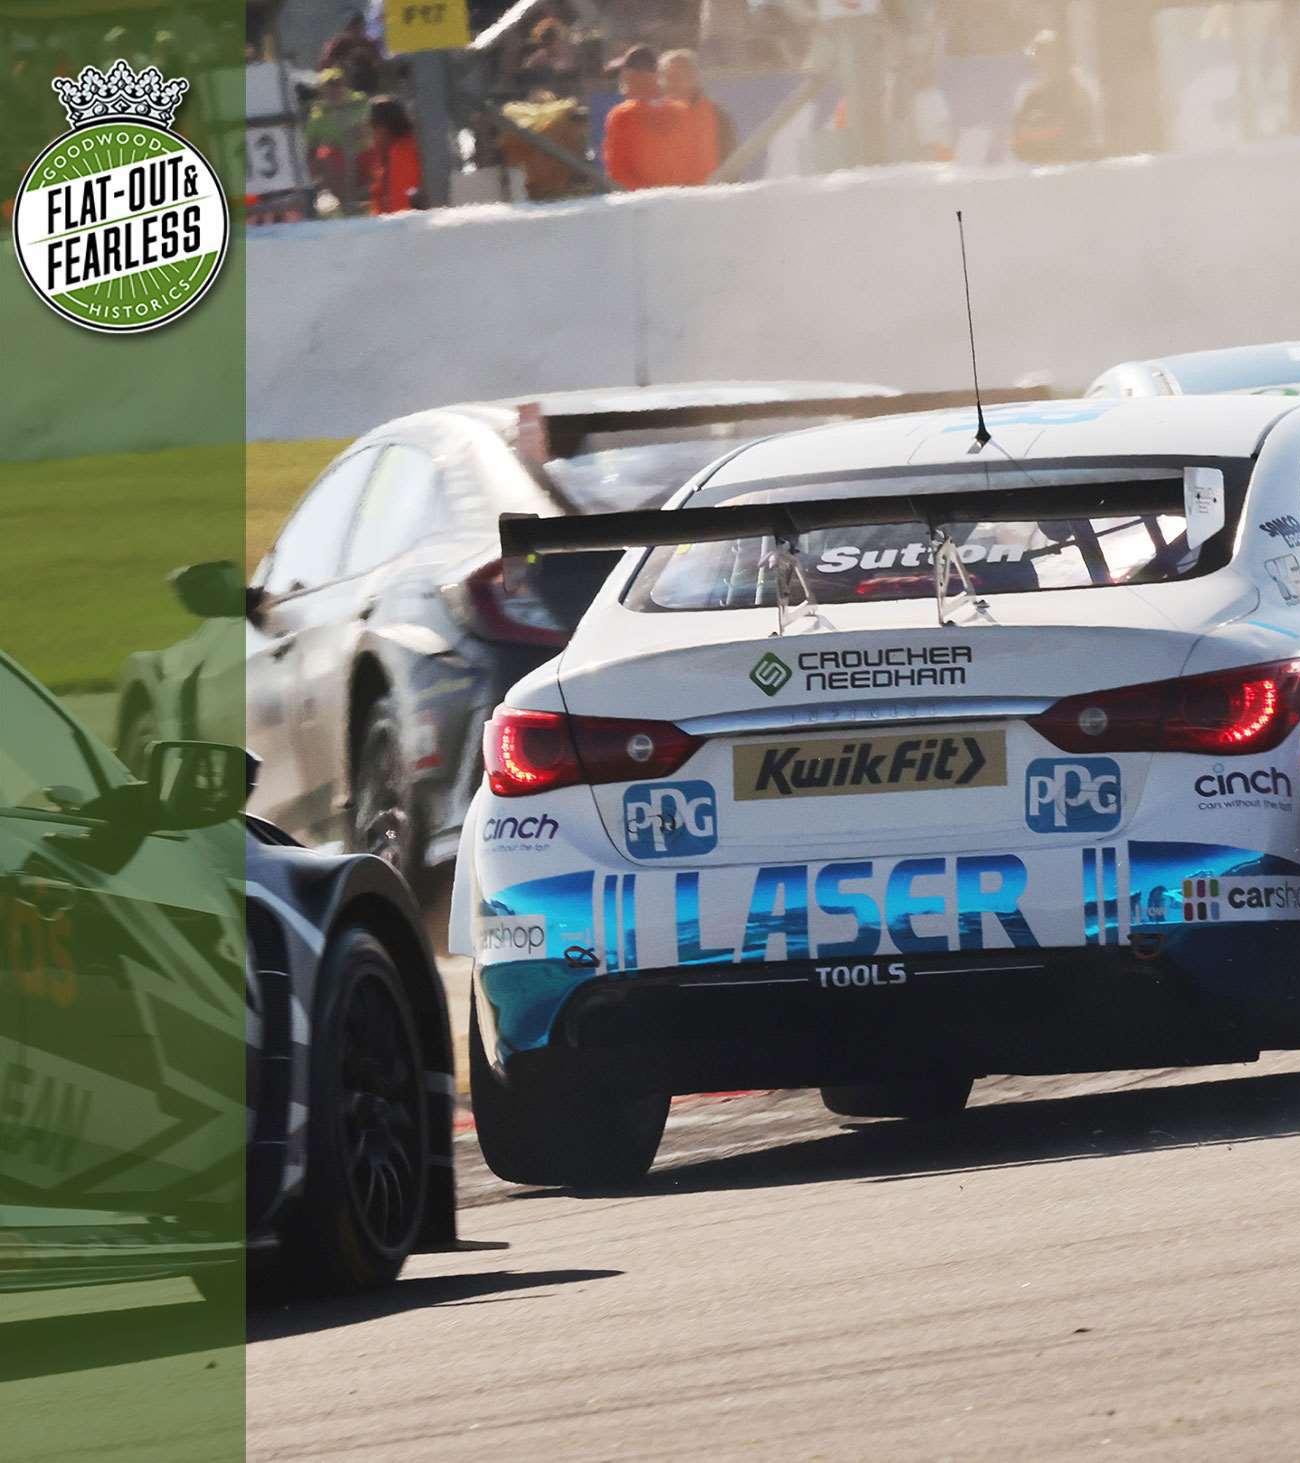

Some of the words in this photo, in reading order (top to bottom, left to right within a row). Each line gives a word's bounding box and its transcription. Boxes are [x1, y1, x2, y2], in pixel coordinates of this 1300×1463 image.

[798, 645, 972, 671] CROUCHER
[806, 666, 966, 691] NEEDHAM
[1028, 764, 1118, 827] PPG
[1194, 762, 1293, 798] cinch
[483, 813, 561, 842] cinch
[626, 788, 714, 852] PPG
[674, 853, 1042, 966] LASER
[815, 963, 907, 988] TOOLS
